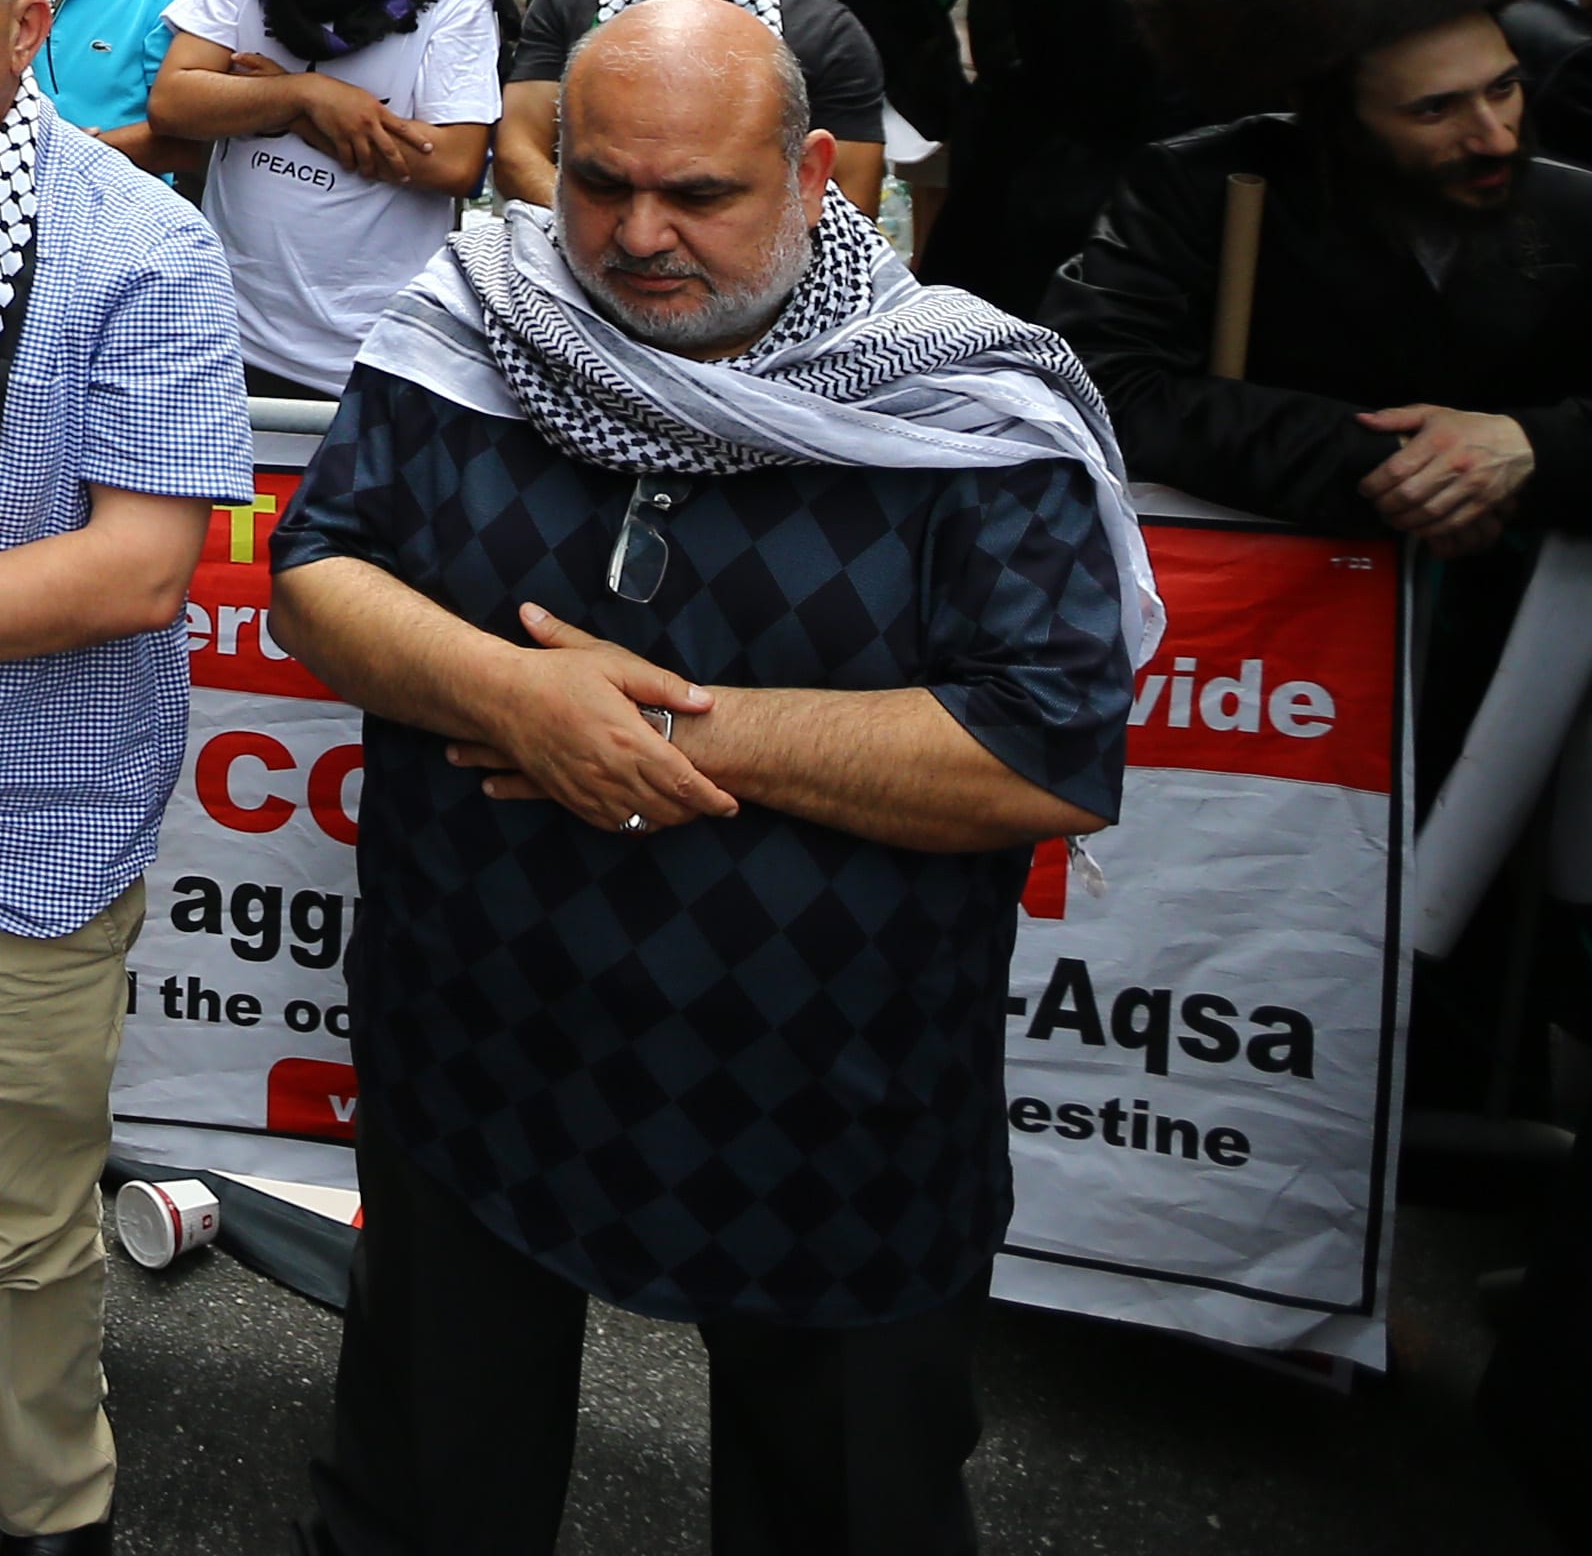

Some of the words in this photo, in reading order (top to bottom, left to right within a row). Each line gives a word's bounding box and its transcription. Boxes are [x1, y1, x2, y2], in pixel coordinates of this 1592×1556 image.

[250, 150, 336, 192] (PEACE)
[160, 975, 262, 1027] the
[1008, 1096, 1251, 1167] estine
